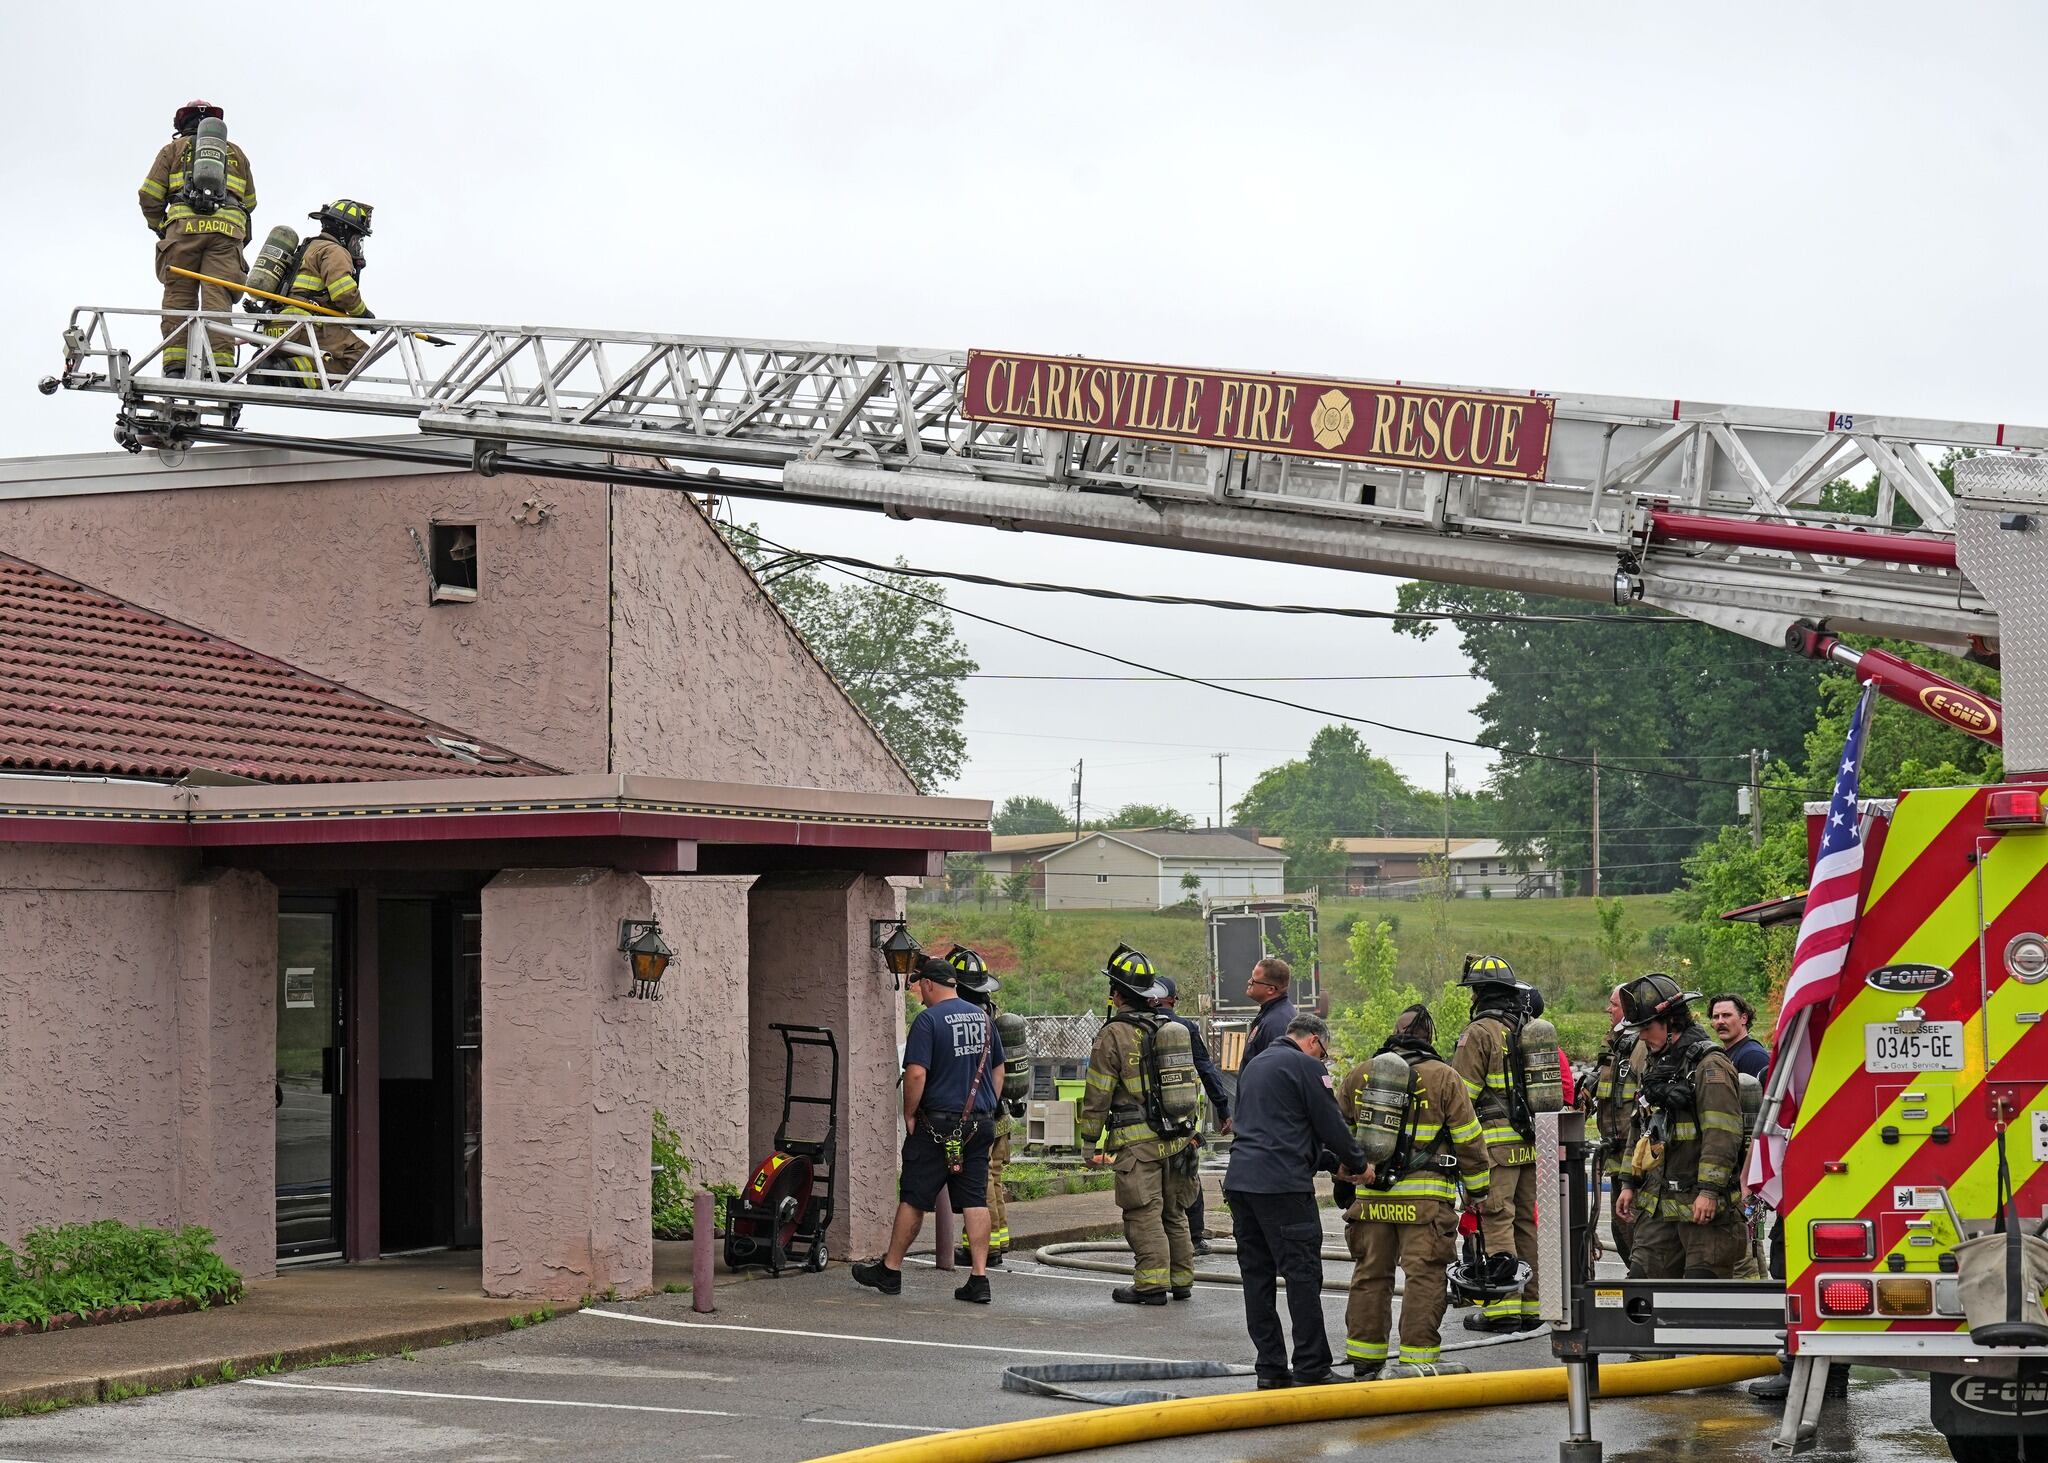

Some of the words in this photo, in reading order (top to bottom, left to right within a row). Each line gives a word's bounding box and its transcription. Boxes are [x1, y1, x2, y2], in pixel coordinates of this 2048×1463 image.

[185, 222, 197, 232] A.
[199, 221, 234, 236] PACOLT
[985, 359, 1205, 436] CLARKSVILLE
[1213, 380, 1297, 444] FIRE
[1369, 393, 1524, 468] RESCUE
[1835, 414, 1853, 430] 45
[1931, 694, 1986, 727] E-ONE
[1879, 970, 1938, 985] E-ONE
[1876, 1036, 1953, 1059] 0345-GE
[1912, 1061, 1940, 1069] Service
[1161, 1072, 1181, 1083] MSA
[1158, 1143, 1169, 1157] R.
[1508, 1148, 1517, 1164] J.
[1520, 1146, 1537, 1163] DAN
[1369, 1203, 1416, 1221] MORRIS
[1964, 1382, 2048, 1401] E-ON
